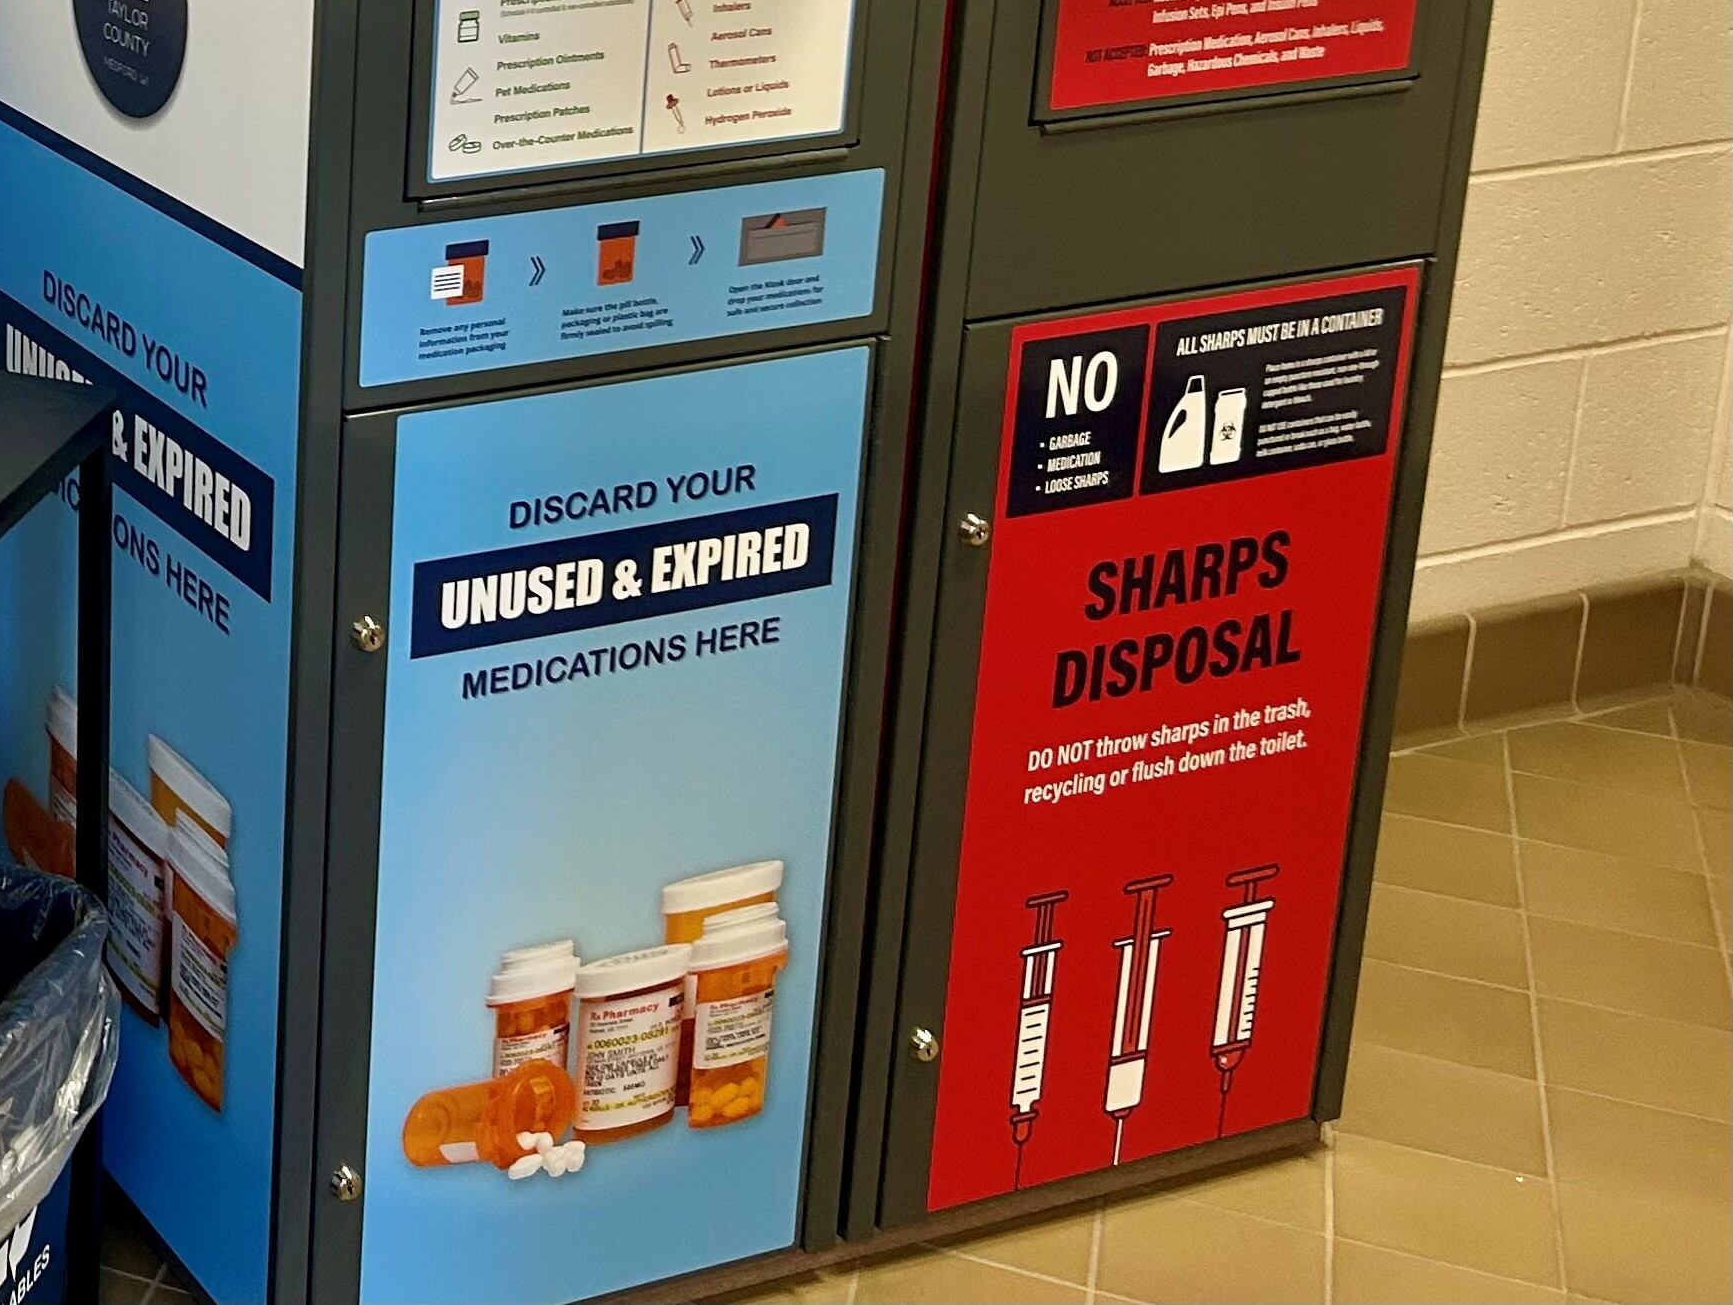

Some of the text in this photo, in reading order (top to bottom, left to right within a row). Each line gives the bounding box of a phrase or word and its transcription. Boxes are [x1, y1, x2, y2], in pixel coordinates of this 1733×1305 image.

[103, 23, 150, 57] COUNTY
[498, 30, 540, 45] Vitamins
[43, 270, 136, 357] DISCARD
[142, 333, 207, 409] YOUR
[1045, 350, 1119, 420] NO
[1047, 451, 1101, 472] MEDICATION
[1049, 431, 1091, 450] GARBAGE
[112, 409, 128, 462] &
[134, 413, 251, 552] EXPIRED
[509, 464, 756, 529] DISCARD YOUR
[1045, 470, 1109, 494] LOOSE SHARPS
[167, 554, 230, 636] HERE
[440, 522, 810, 630] UNUSED & EXPIRED
[1084, 529, 1291, 621] SHARPS
[461, 616, 781, 700] MEDICATIONS HERE
[1052, 609, 1301, 709] DISPOSAL
[1024, 729, 1308, 805] recycling or flush down the toilet.
[1028, 697, 1312, 772] DO NOT throw sharps in the trash,
